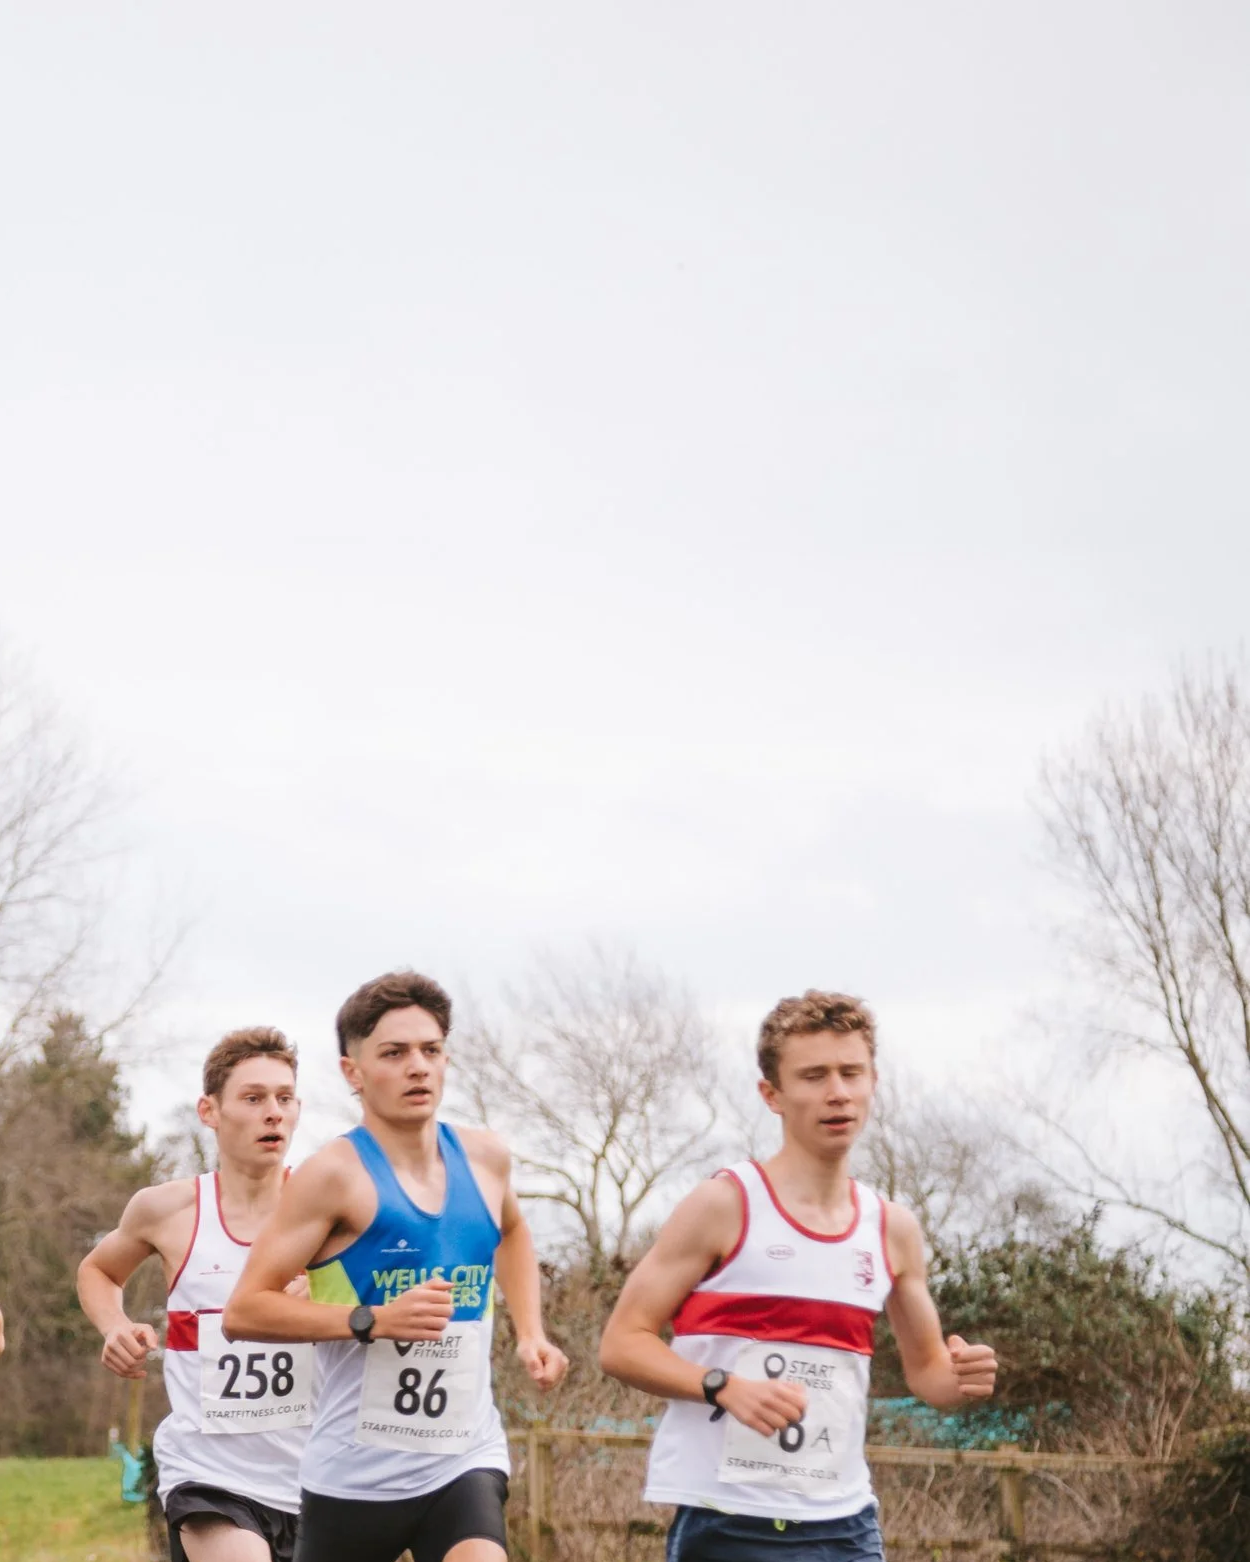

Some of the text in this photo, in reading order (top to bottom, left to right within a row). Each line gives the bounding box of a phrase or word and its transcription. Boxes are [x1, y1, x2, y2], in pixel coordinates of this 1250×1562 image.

[450, 1264, 490, 1286] CITY
[384, 1286, 482, 1307] HERS
[413, 1348, 460, 1359] FITNESS
[218, 1351, 295, 1400] 258
[789, 1360, 836, 1378] START
[394, 1367, 448, 1419] 86
[205, 1403, 307, 1419] STARTFITNESS.CO.UK
[361, 1421, 471, 1438] STARTFITNESS.CO.UK
[810, 1426, 834, 1454] A
